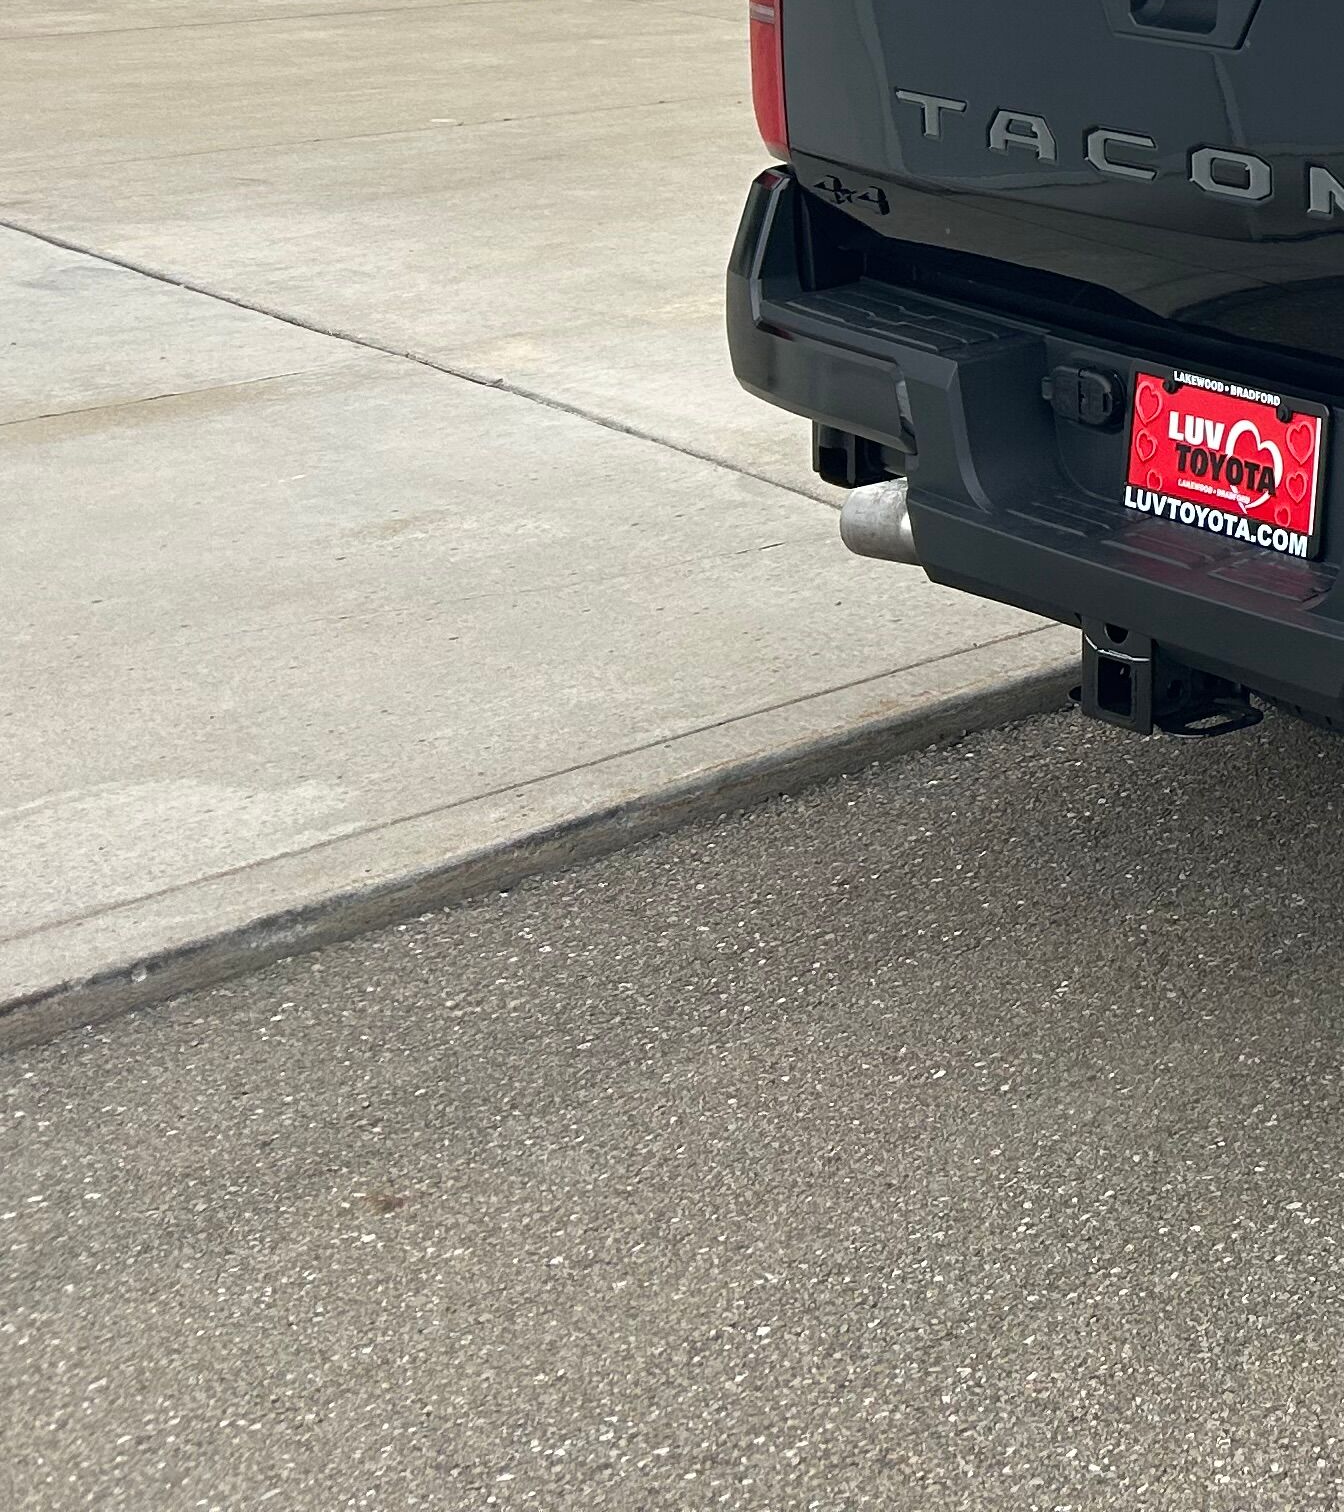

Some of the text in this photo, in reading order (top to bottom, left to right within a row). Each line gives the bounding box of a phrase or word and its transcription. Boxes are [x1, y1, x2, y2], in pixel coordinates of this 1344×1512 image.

[1173, 370, 1281, 407] LAKEWOOD BRADFORD
[1168, 410, 1225, 451] LUV
[1175, 444, 1277, 496] TOYOTA
[1124, 485, 1309, 559] LUVTOYOTA.COM
